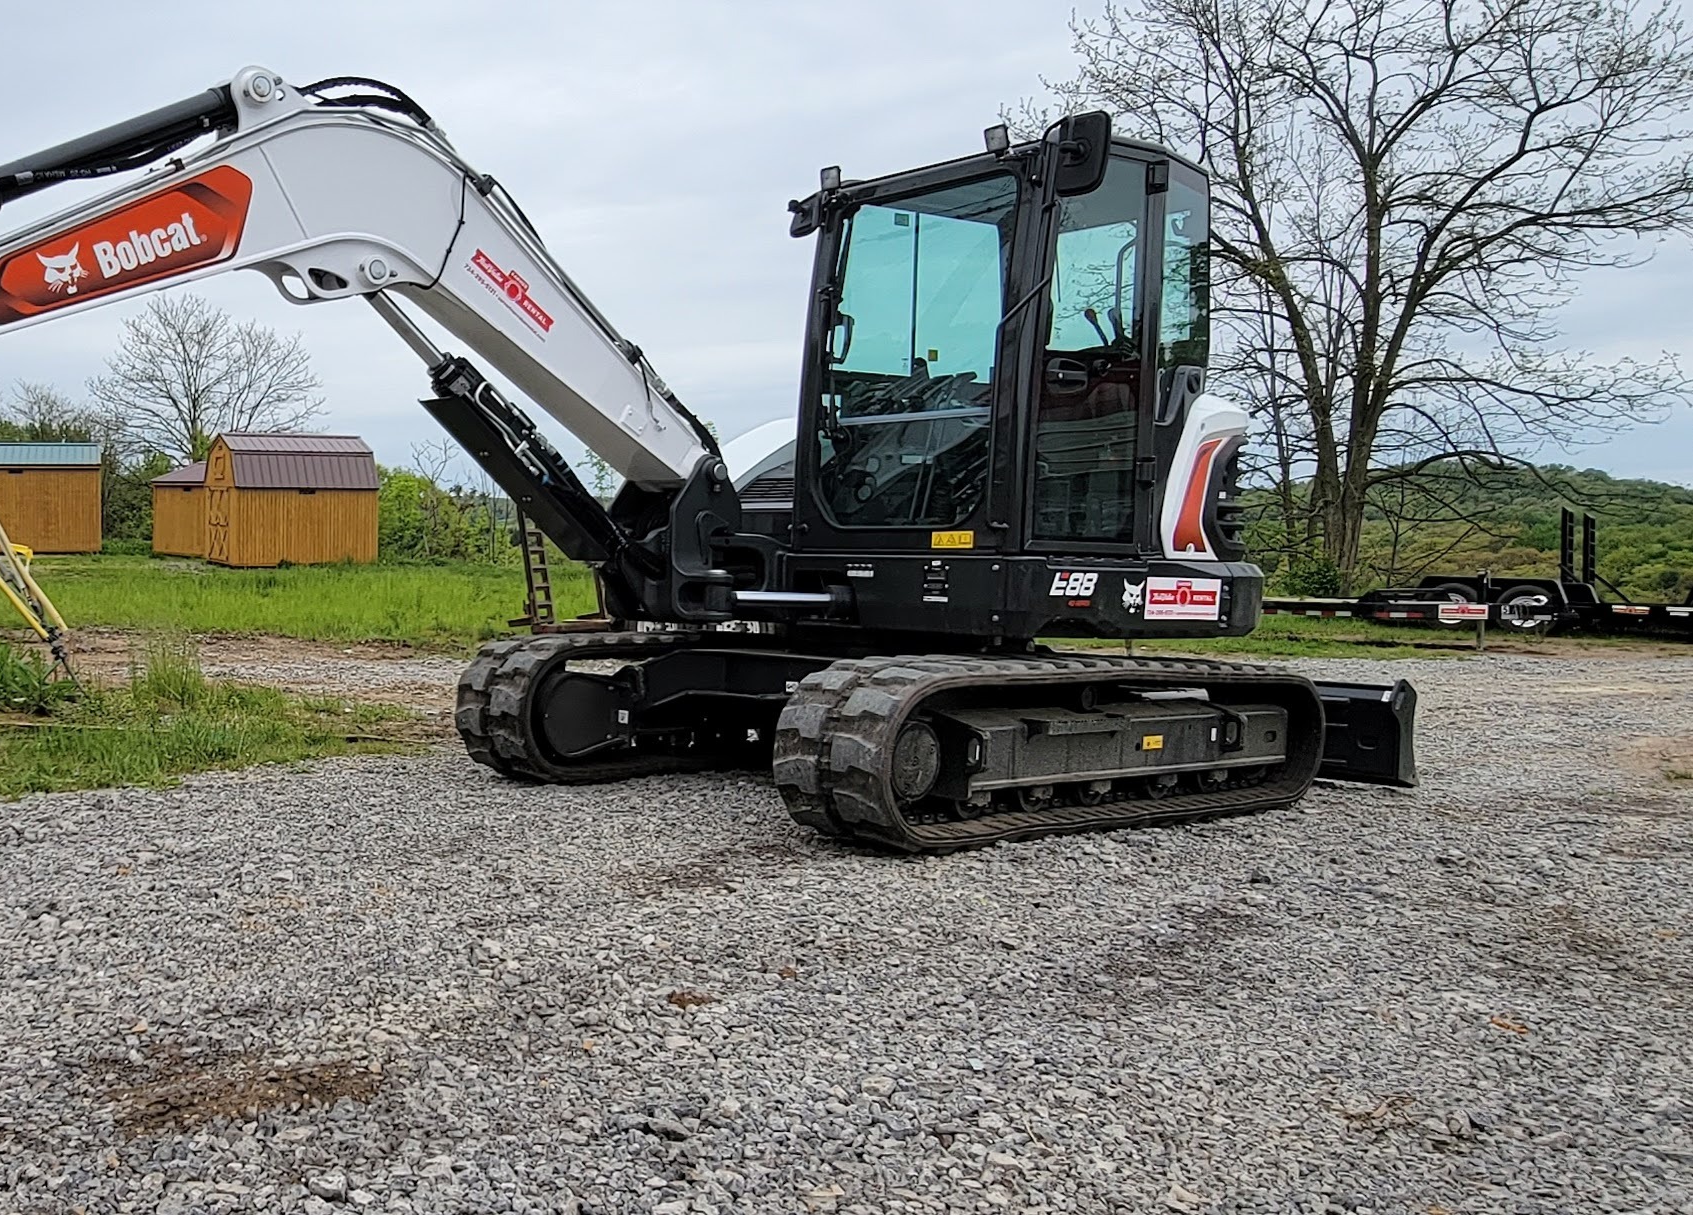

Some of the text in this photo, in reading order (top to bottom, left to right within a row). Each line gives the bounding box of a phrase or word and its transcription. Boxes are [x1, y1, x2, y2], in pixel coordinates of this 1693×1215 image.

[92, 212, 201, 279] Bobcat
[522, 300, 547, 325] RENTAL
[1049, 571, 1099, 596] E88
